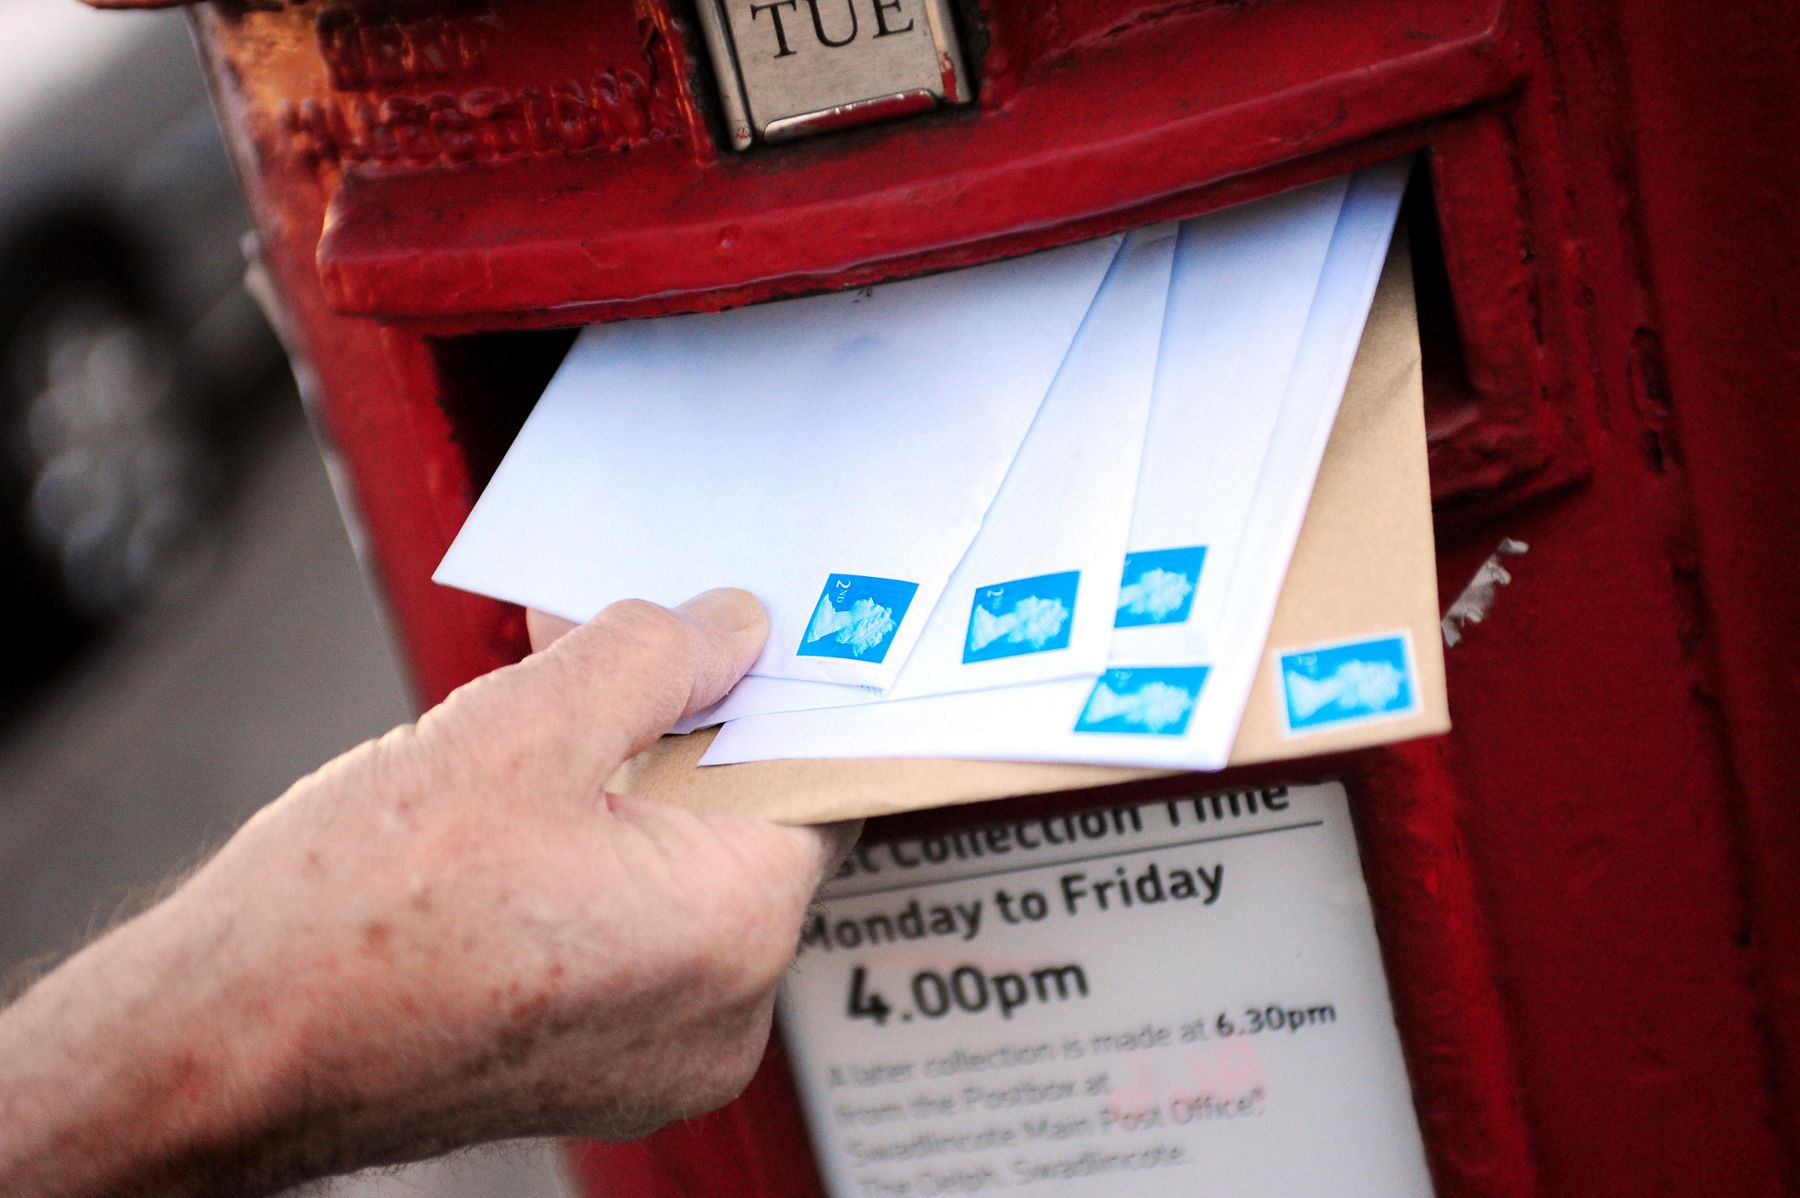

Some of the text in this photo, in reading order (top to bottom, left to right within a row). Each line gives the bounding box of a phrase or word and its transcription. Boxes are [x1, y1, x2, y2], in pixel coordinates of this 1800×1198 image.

[751, 0, 914, 58] TUE
[798, 862, 1223, 952] Monday to Friday
[847, 964, 1090, 1026] 4.00pm
[1062, 1037, 1085, 1060] is
[1091, 1023, 1171, 1053] made
[1179, 1017, 1207, 1043] at
[1216, 1004, 1337, 1038] 6.30pm
[1098, 1103, 1164, 1133] Post
